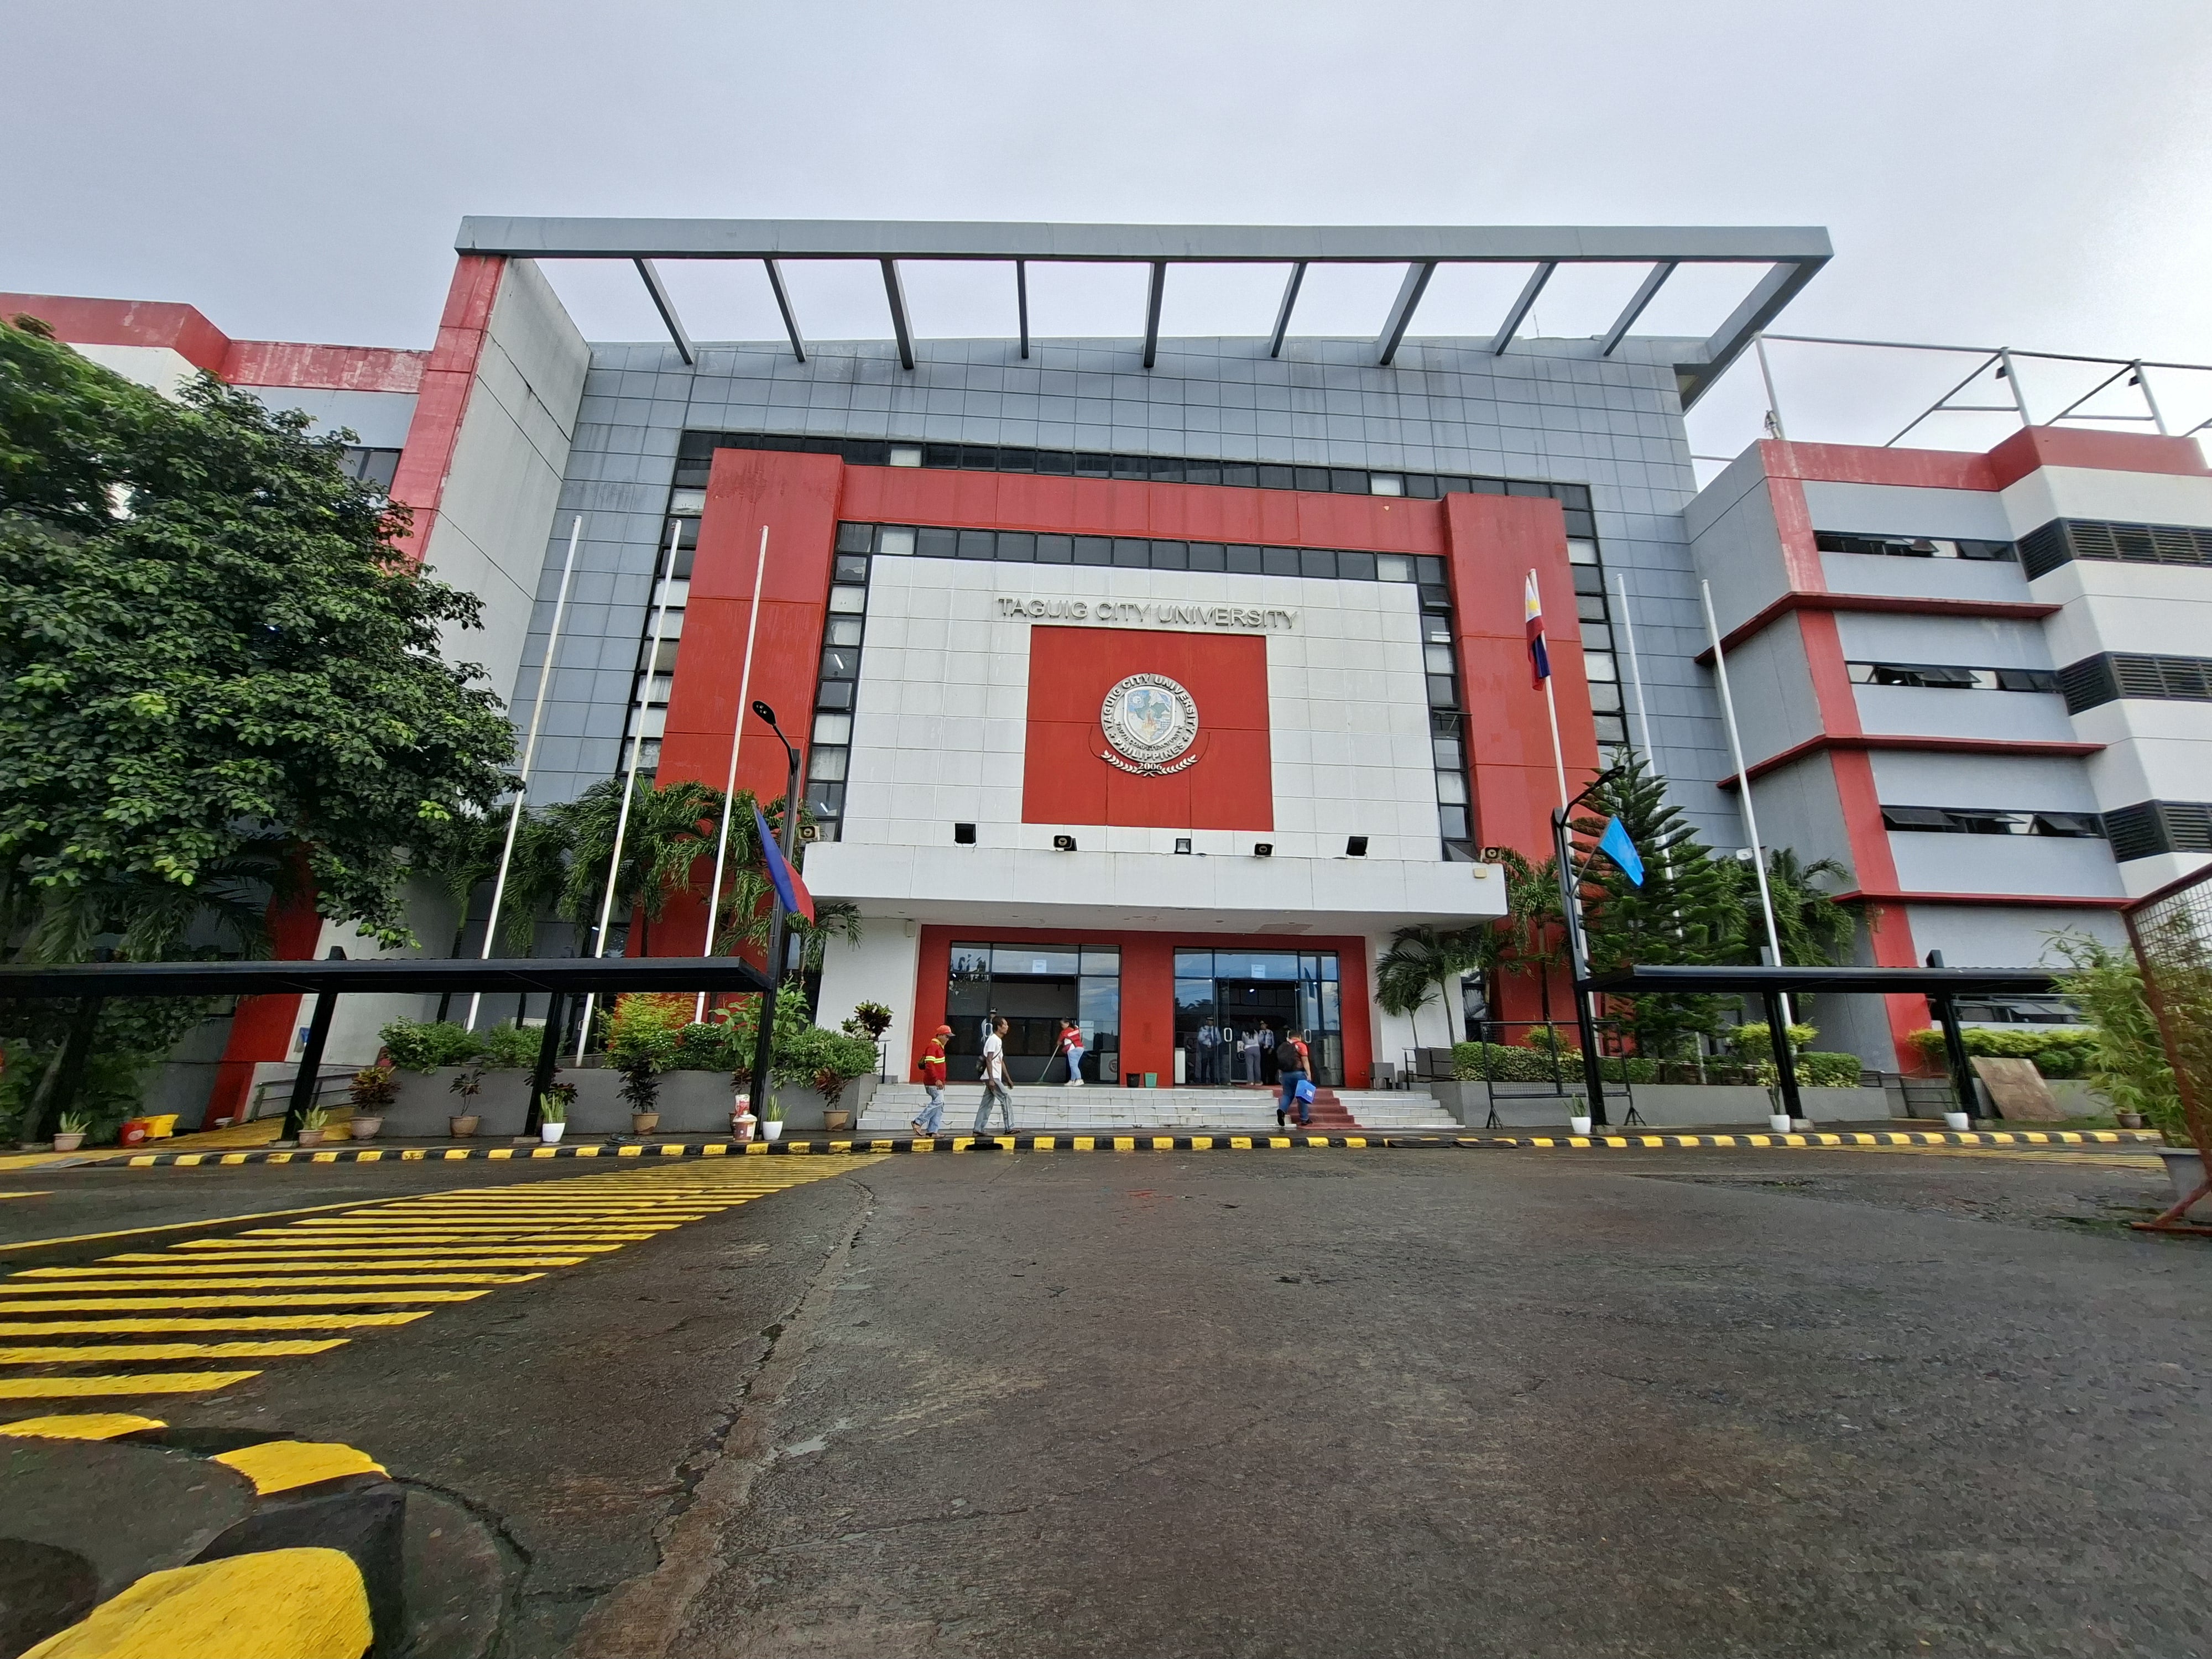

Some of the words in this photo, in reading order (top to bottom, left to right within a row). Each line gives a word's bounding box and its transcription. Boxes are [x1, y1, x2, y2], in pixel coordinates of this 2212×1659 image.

[998, 597, 1088, 620] TAGUIG
[1095, 601, 1151, 623] CITY
[1158, 604, 1298, 629] UNIVERSITY
[1104, 687, 1121, 731] TAGUIG
[1122, 674, 1151, 689] CITY
[1154, 675, 1196, 735] UNIVERSITY
[1113, 738, 1185, 761] PHILIPPINES
